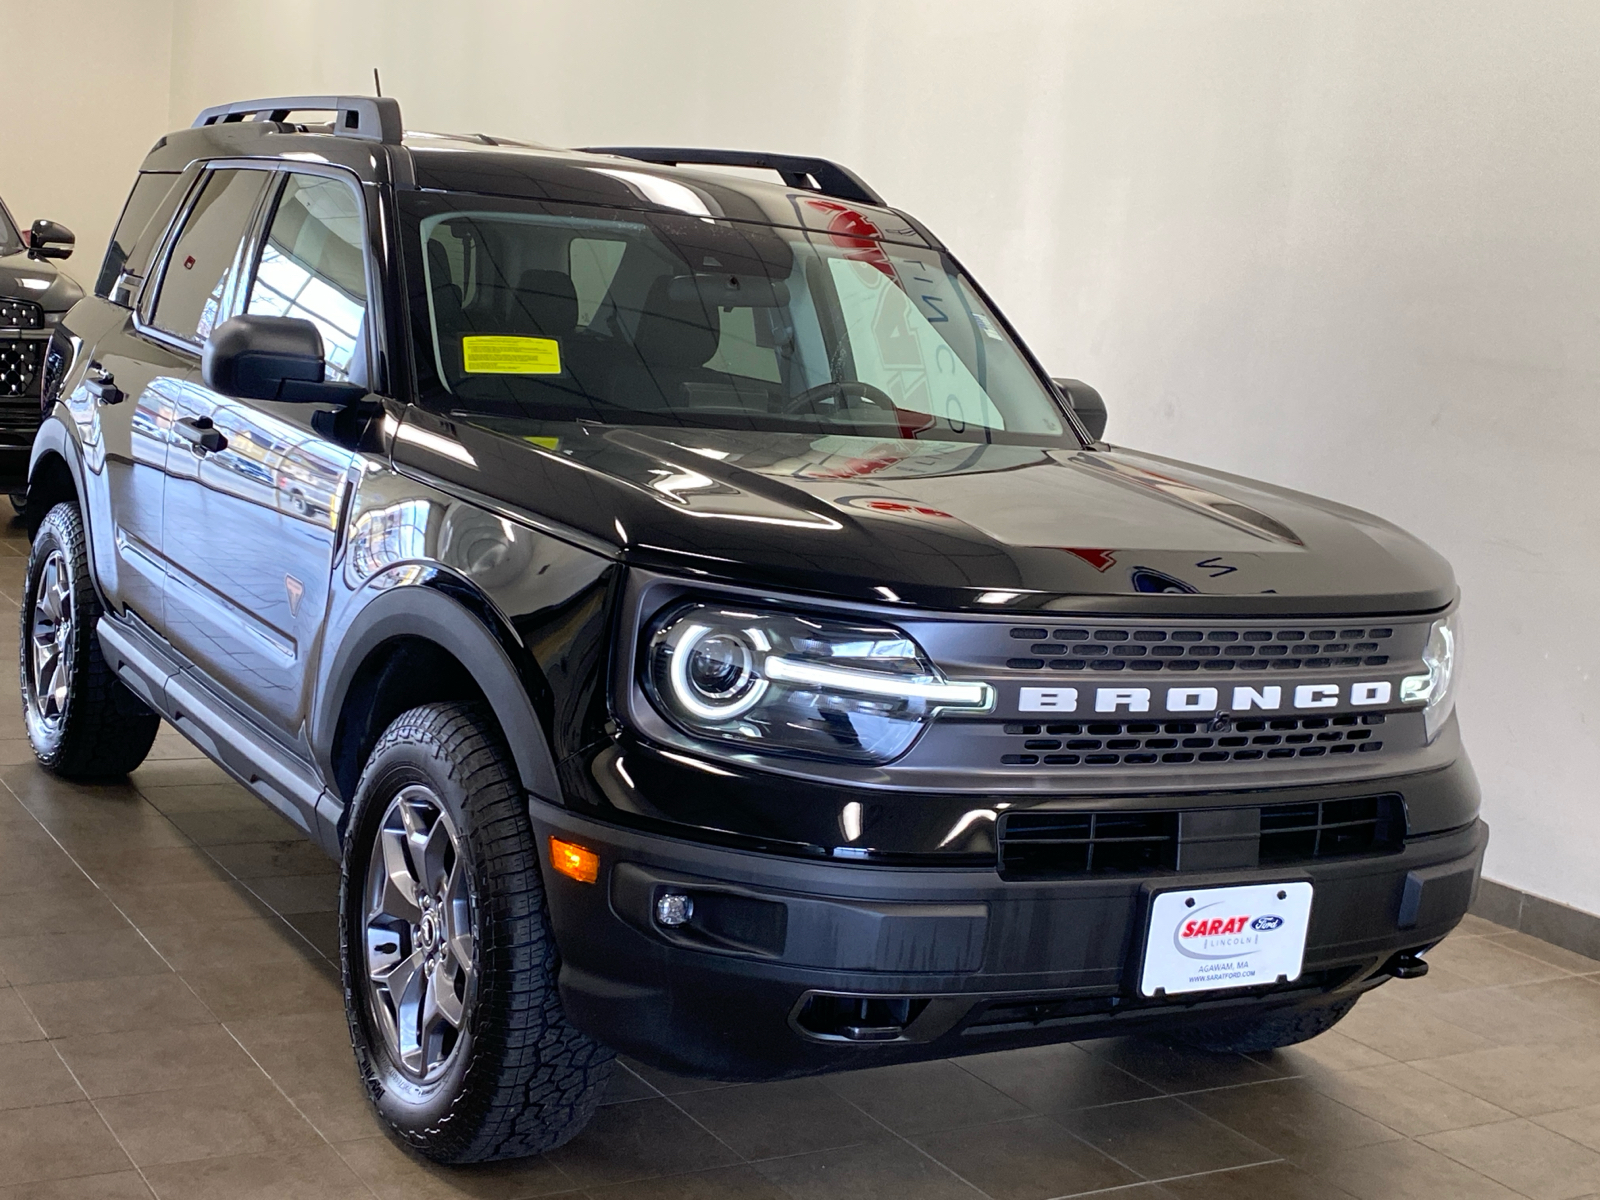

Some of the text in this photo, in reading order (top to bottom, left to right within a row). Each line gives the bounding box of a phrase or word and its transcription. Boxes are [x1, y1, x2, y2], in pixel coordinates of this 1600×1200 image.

[1018, 682, 1391, 712] BRONCO
[1181, 916, 1279, 938] SARAT Ford
[1210, 937, 1251, 947] LINCOLN
[1198, 961, 1249, 973] AGAWAM, MA
[1189, 970, 1256, 983] WWW.SARATFORD.COM
